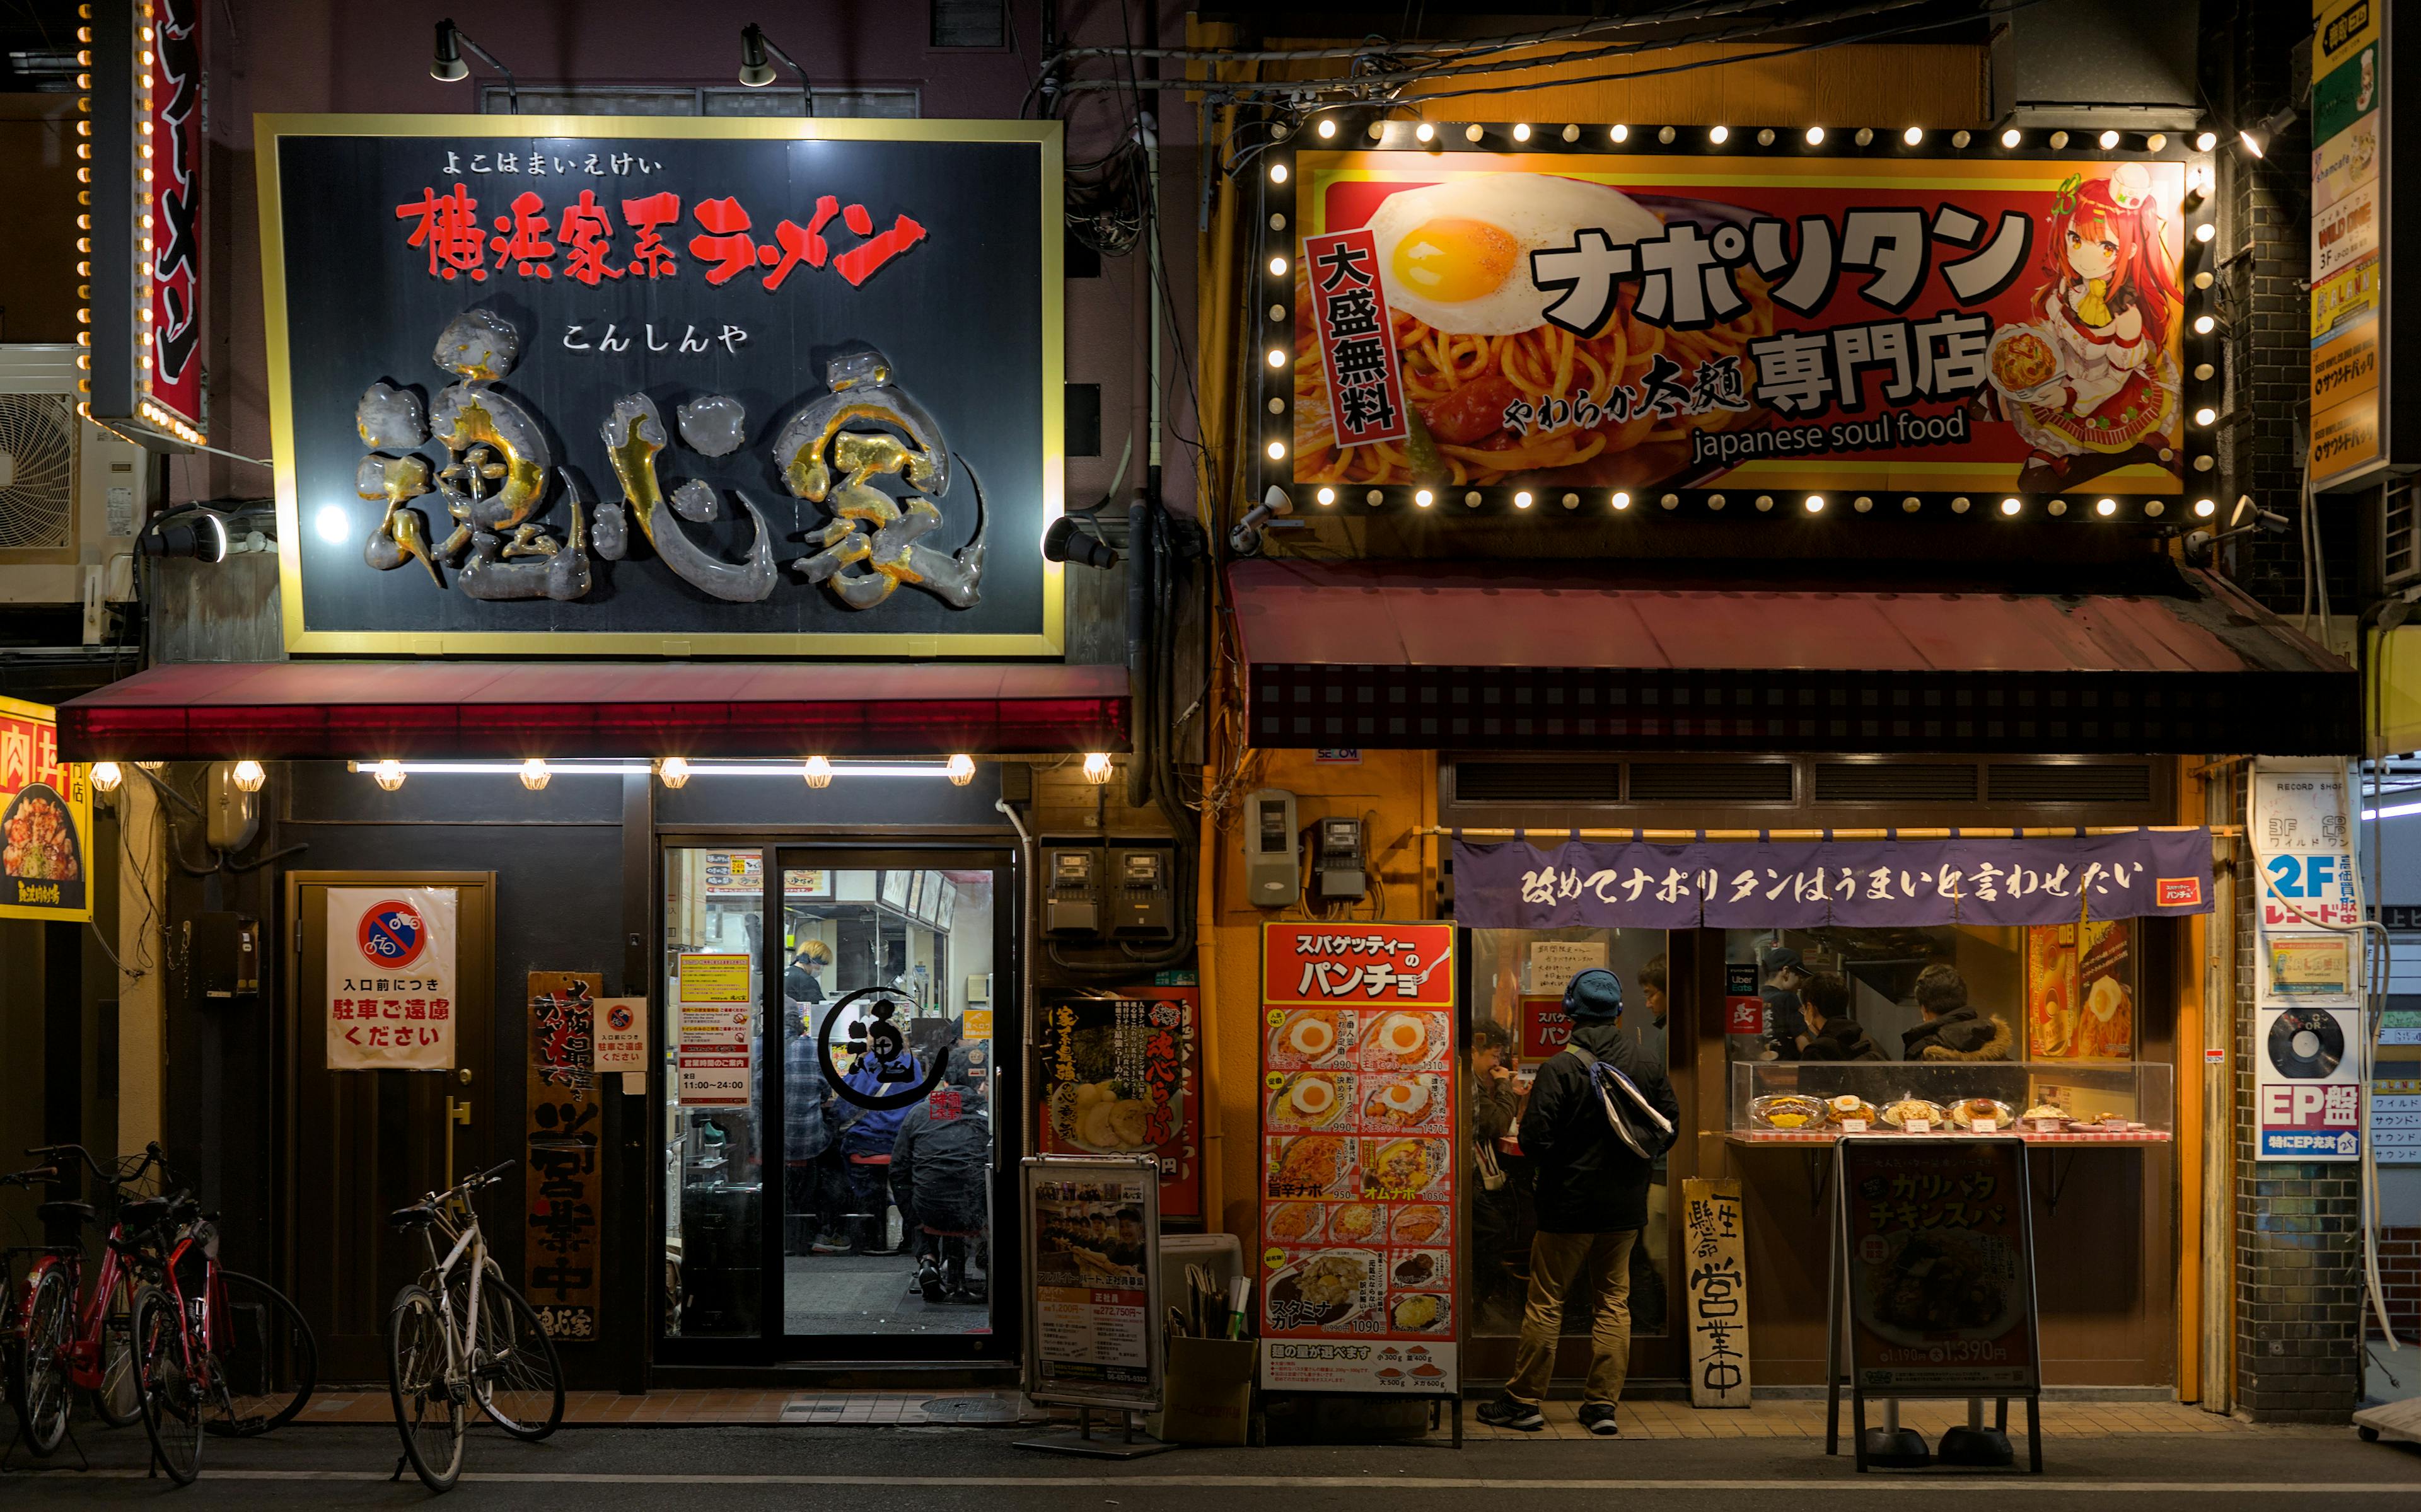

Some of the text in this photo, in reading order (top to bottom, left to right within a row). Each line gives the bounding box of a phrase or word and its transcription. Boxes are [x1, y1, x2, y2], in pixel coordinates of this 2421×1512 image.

[442, 151, 663, 176] よこはまいえけい
[2319, 217, 2346, 250] WILD
[2347, 201, 2371, 233] ONE
[1532, 205, 2031, 335] ナポリタン
[2320, 250, 2331, 270] 3F
[562, 323, 750, 354] こんしんや
[1318, 242, 1394, 434] 大盛無料
[1751, 313, 1987, 415] 専門店
[1502, 354, 1750, 435] やわらか太麺
[1693, 409, 1965, 463] japanese soul food
[354, 309, 990, 609] 魂心家
[1318, 748, 1357, 759] SECOM
[2269, 816, 2346, 836] 3F CD
[2322, 826, 2346, 838] LP
[2270, 838, 2319, 848] ワイルド
[1520, 861, 2143, 906] 改めてナポリタンはうまいと言わせたい
[2267, 854, 2335, 898] 2F
[2265, 904, 2339, 925] レコード
[1296, 935, 1415, 955] スパゲッティー
[1404, 954, 1420, 967] の
[344, 979, 438, 991] 入口前につき
[1297, 961, 1419, 998] パンチョ
[1731, 975, 1753, 984] Uber
[1731, 984, 1753, 992] Eats
[332, 999, 450, 1020] 駐車ご遠慮
[345, 1026, 439, 1046] ください
[1337, 1012, 1345, 1055] これが定番
[1346, 1014, 1354, 1046] 一番人気
[598, 1042, 643, 1052] 駐車ご遠慮
[602, 1052, 639, 1062] ください
[1054, 1005, 1081, 1141] 家系最強の心意気
[1270, 1061, 1300, 1069] 目玉焼き
[2263, 1085, 2358, 1126] EP盤
[2376, 1099, 2418, 1107] ワイルド
[1269, 1124, 1299, 1132] 目玉焼き
[1362, 1124, 1399, 1133] 大王セット
[2375, 1133, 2416, 1141] サウンド
[2268, 1136, 2337, 1150] 特にEP充実
[2340, 1140, 2354, 1152] 2F
[2376, 1150, 2417, 1158] サウンド
[1269, 1182, 1322, 1198] 旨辛ナポ
[1364, 1186, 1417, 1201] オムナポ
[528, 1102, 598, 1302] 営業中
[1711, 1194, 1740, 1238] 一生
[1869, 1200, 2007, 1231] チキンスパ
[1094, 1293, 1119, 1303] 正社員
[1271, 1300, 1332, 1318] スタミナ
[1272, 1315, 1317, 1330] カレー
[1691, 1257, 1744, 1399] 営業中
[1270, 1344, 1371, 1360] 麺の量が選べます
